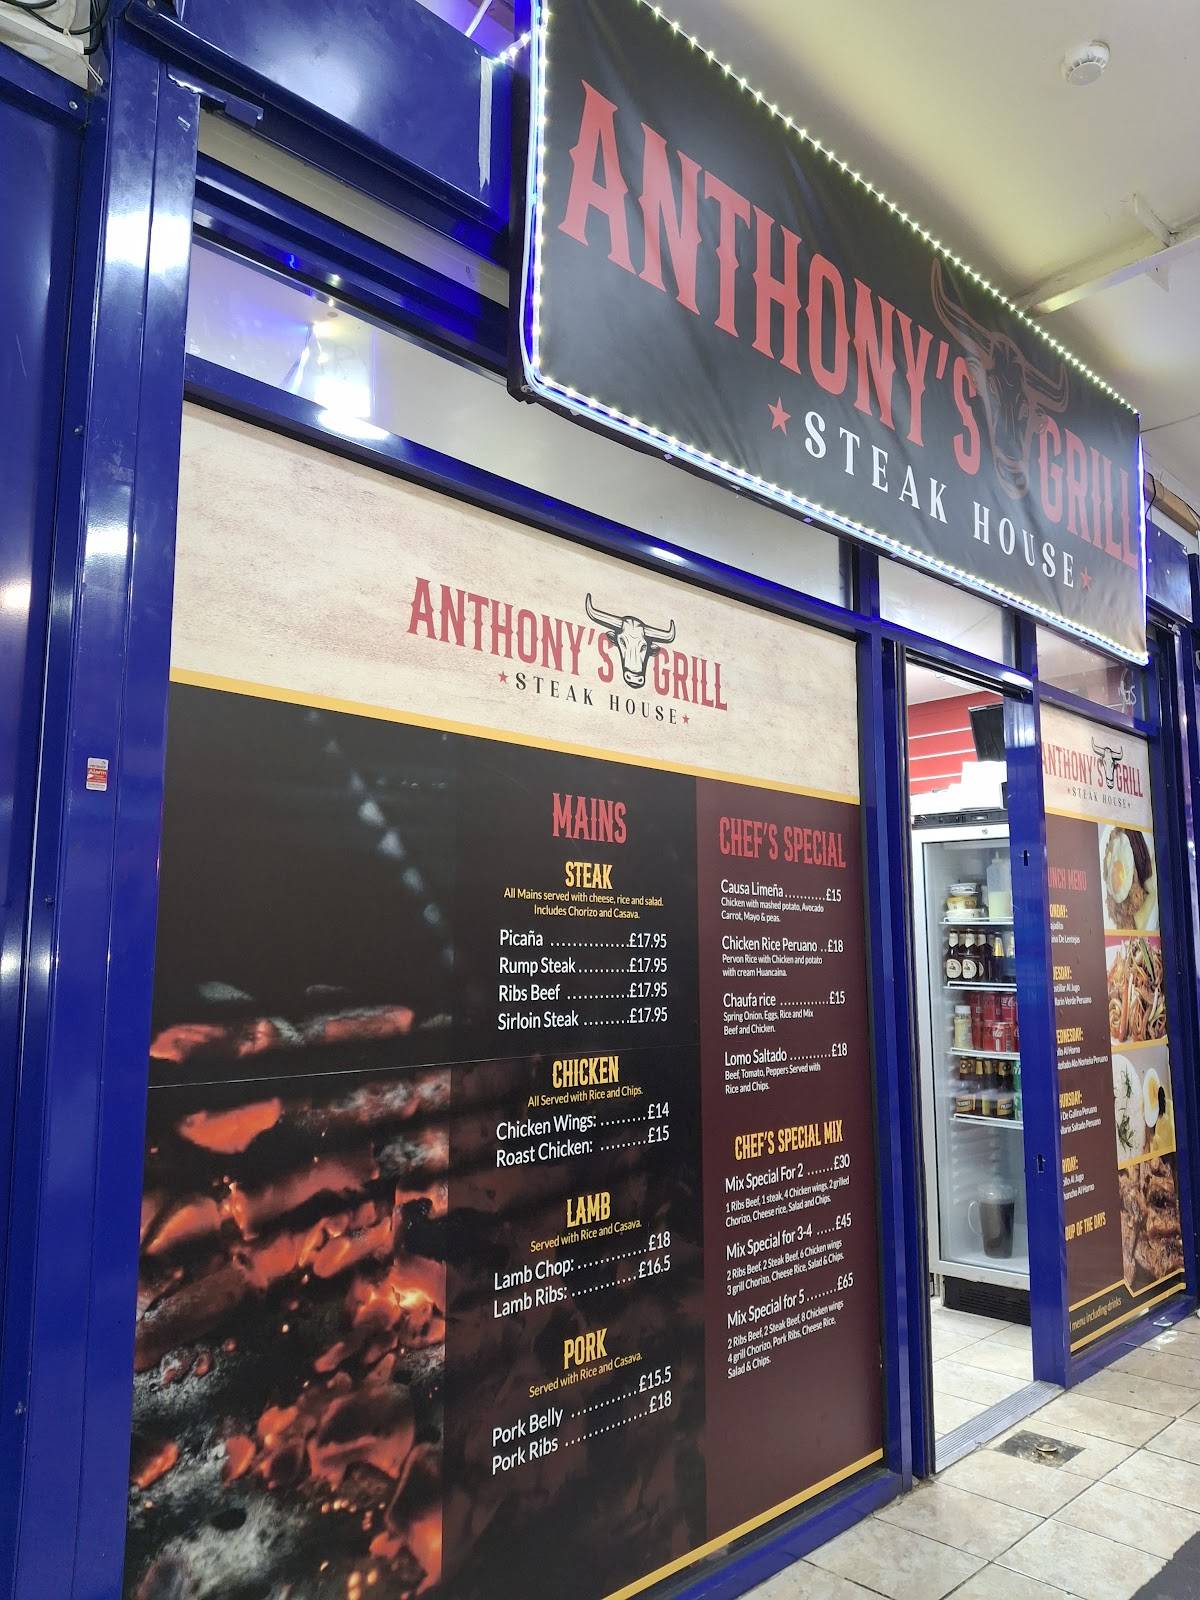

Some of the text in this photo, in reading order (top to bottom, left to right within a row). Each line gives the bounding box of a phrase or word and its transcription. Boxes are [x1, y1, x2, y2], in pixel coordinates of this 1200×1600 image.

[558, 79, 1139, 571] ANTHONY'S GRILL
[804, 411, 1075, 588] STEAK HOUSE
[406, 576, 728, 711] ANTHONY'S GRILL
[515, 672, 677, 725] STEAK HOUSE
[1115, 762, 1143, 798] GRILL
[1072, 786, 1127, 809] STEAK HOUSE
[552, 792, 627, 842] MAINS
[719, 817, 847, 867] CHEF'S SPECIAL
[565, 862, 612, 889] STEAK
[721, 879, 841, 902] Causa Limeña £15
[504, 888, 664, 906] All Mains served with cheese, rice and salad.
[534, 905, 640, 918] Includes Chorizo and Casava.
[721, 897, 745, 907] Chicken
[746, 899, 759, 908] with
[760, 900, 781, 909] mashed
[802, 903, 824, 912] Avocado
[744, 911, 760, 922] Mayo
[761, 913, 766, 921] &
[766, 915, 780, 923] peas.
[500, 929, 666, 948] Picaña £17.95
[722, 935, 843, 952] Chicken Rice Peruano £18
[499, 957, 667, 976] Rump Steak £17.95
[722, 967, 736, 976] with
[737, 969, 755, 977] cream
[745, 954, 757, 963] Rice
[758, 954, 771, 963] with
[772, 954, 794, 964] Chicken
[795, 955, 804, 964] and
[805, 956, 822, 965] potato
[499, 982, 667, 1001] Ribs Beef £17.95
[723, 990, 845, 1007] Chaufa rice £15
[498, 1007, 667, 1030] Sirloin Steak £17.95
[724, 1024, 775, 1035] Beef and Chicken.
[725, 1043, 847, 1066] Lomo Saltado £18
[552, 1056, 619, 1088] CHICKEN
[528, 1085, 643, 1107] All Served with Rice and Chips.
[496, 1102, 669, 1140] Chicken Wings: £14
[496, 1125, 669, 1167] Roast Chicken: £15
[735, 1120, 843, 1160] CHEF'S SPECIAL MIX
[726, 1154, 850, 1193] Mix Special For 2 £30
[566, 1192, 610, 1227] LAMB
[1084, 1215, 1093, 1233] THE
[530, 1220, 642, 1252] Served with Rice and Casava.
[726, 1212, 851, 1260] Mix Special for 3-4 £45
[495, 1231, 671, 1290] Lamb Chop: £18
[494, 1255, 671, 1318] Lamb Ribs: £16.5
[728, 1272, 853, 1329] Mix Special for 5 £65
[728, 1338, 732, 1349] 2
[733, 1335, 747, 1347] Ribs
[764, 1325, 768, 1336] 2
[769, 1320, 785, 1334] Steak
[801, 1312, 805, 1322] 8
[806, 1306, 828, 1320] Chicken
[829, 1300, 844, 1311] wings
[564, 1329, 608, 1369] PORK
[529, 1353, 642, 1398] Served with Rice and Casava.
[728, 1356, 771, 1379] Salad & Chips.
[493, 1366, 671, 1447] Pork Belly £15.5
[493, 1390, 671, 1475] Pork Ribs £18
